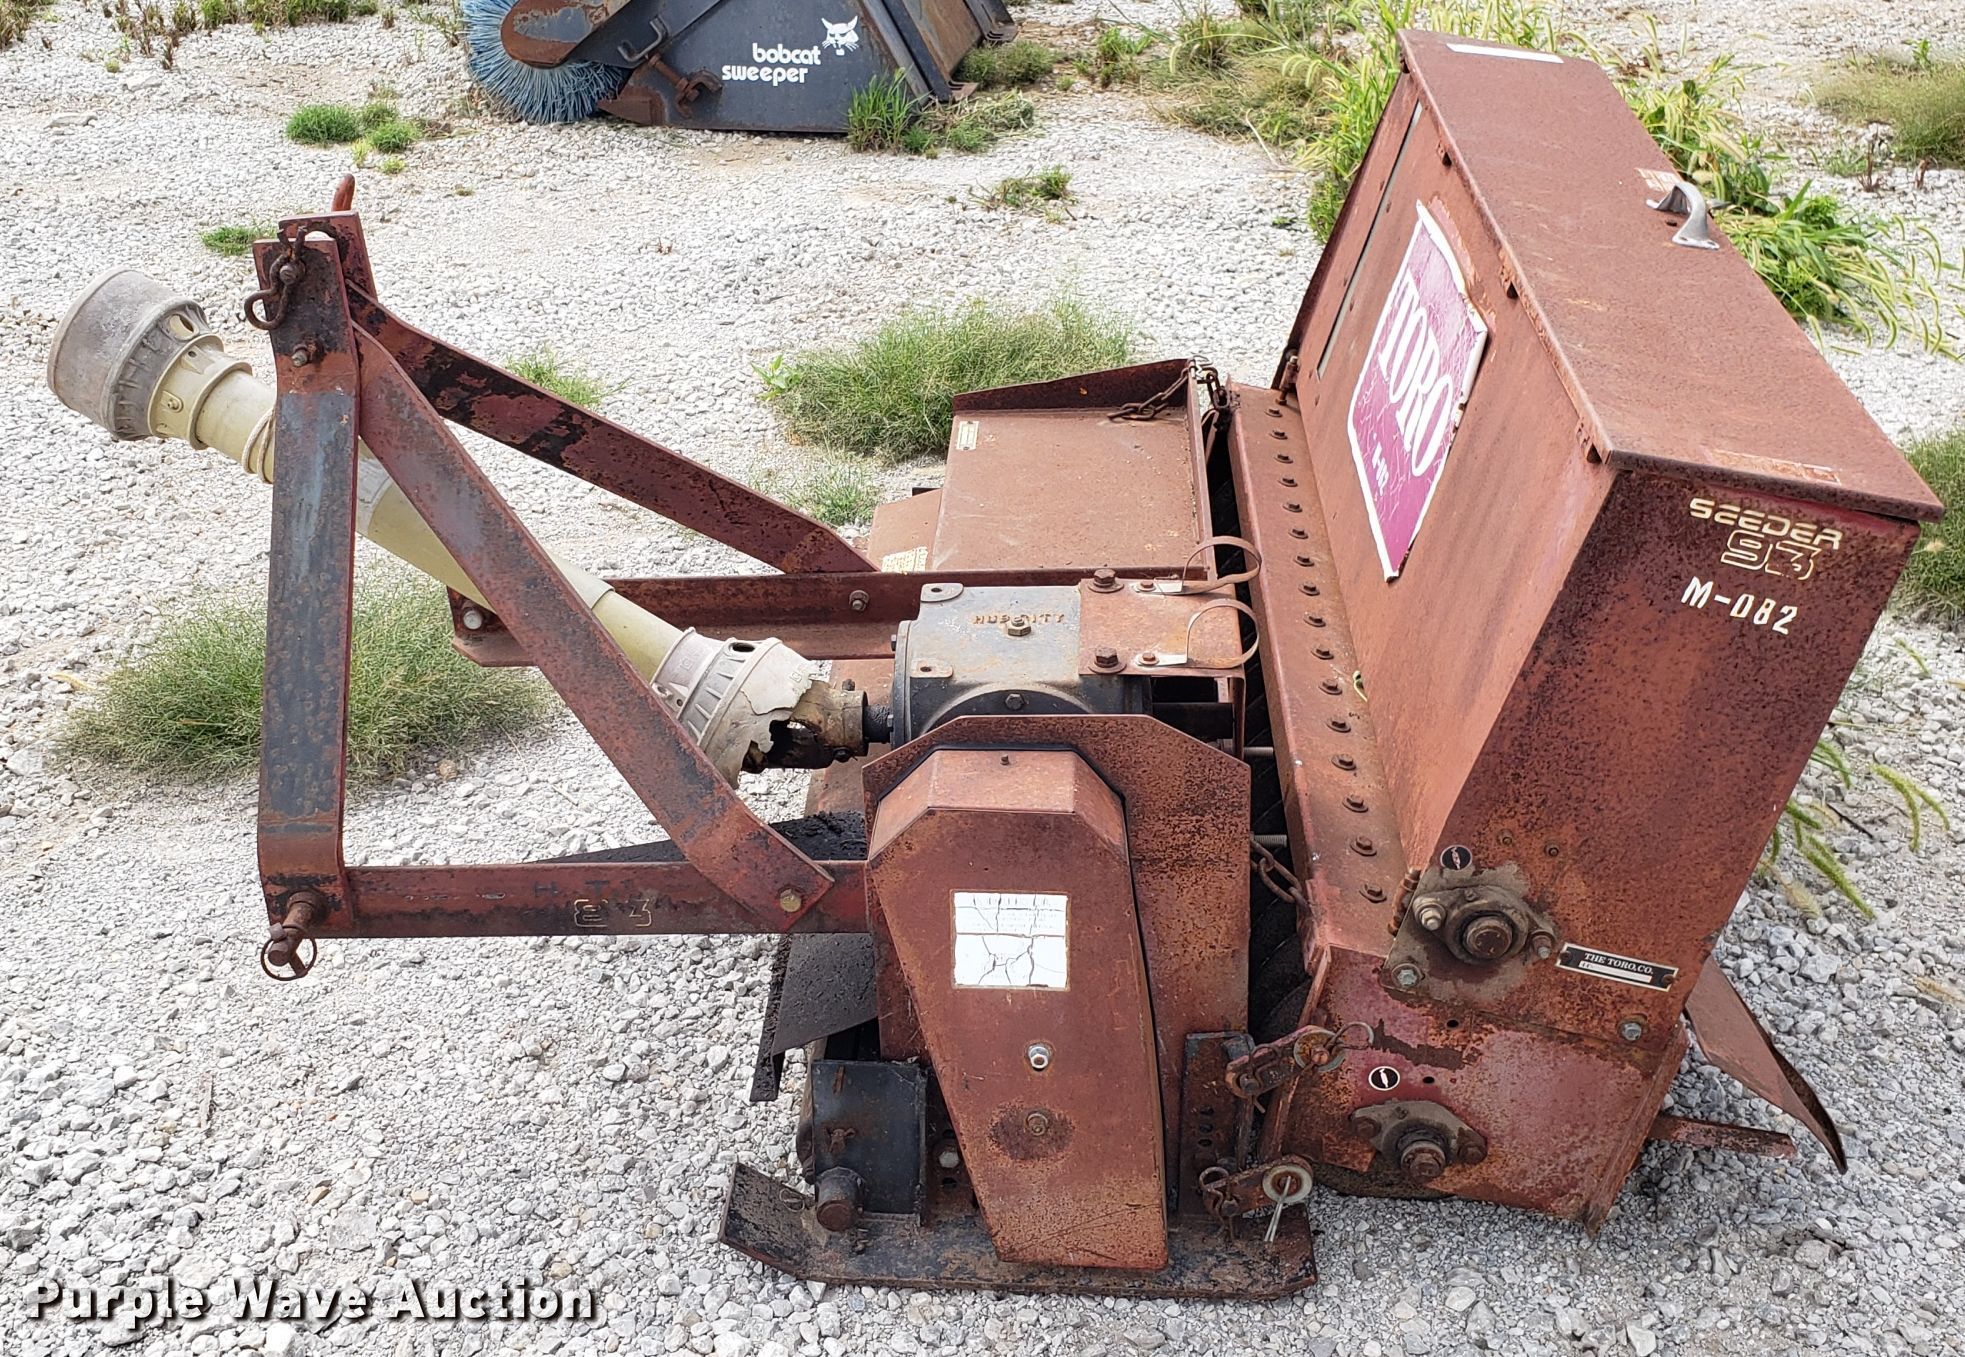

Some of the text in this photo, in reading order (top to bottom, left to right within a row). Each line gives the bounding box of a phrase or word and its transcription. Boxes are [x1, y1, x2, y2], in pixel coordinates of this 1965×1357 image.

[752, 42, 822, 66] bobcat
[721, 64, 809, 87] sweeper
[1377, 268, 1453, 478] TORO
[1689, 497, 1844, 551] SEEDER
[1680, 575, 1798, 636] M-082
[1584, 952, 1607, 964] THE
